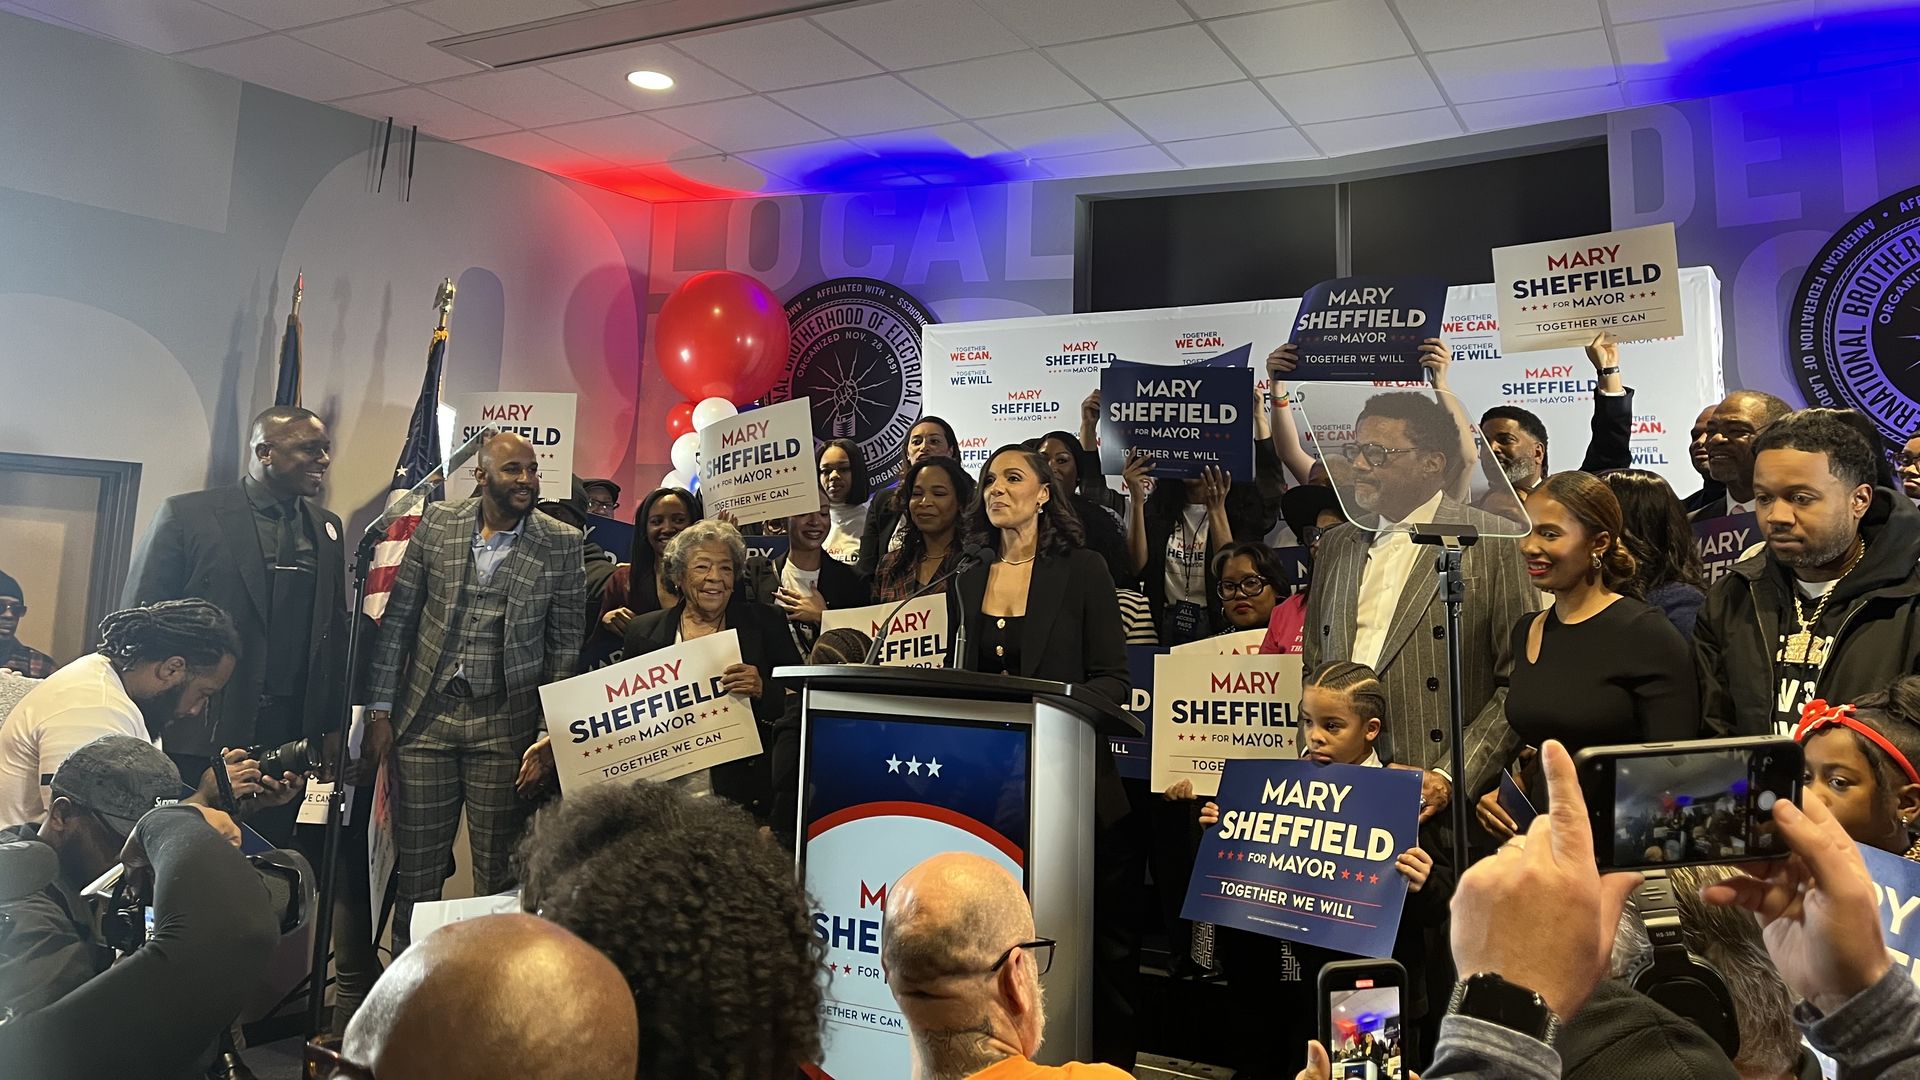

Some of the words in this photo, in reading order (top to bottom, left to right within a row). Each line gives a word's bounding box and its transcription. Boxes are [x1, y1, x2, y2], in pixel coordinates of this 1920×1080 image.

[1820, 218, 1876, 275] AMERICAN
[1547, 244, 1621, 271] MARY
[1513, 263, 1662, 299] SHEFFIELD
[816, 283, 863, 300] AFFILIATED
[864, 284, 886, 297] WITH
[1328, 287, 1394, 306] MARY
[1572, 292, 1625, 308] MAYOR
[867, 311, 888, 331] OF
[1297, 309, 1427, 330] SHEFFIELD
[1536, 319, 1597, 332] TOGETHER
[1602, 315, 1618, 325] WE
[1622, 312, 1646, 323] CAN
[1800, 276, 1828, 351] FEDERATION
[1443, 323, 1466, 333] WE
[1063, 341, 1099, 352] MARY
[1175, 339, 1194, 349] WE
[1196, 337, 1225, 348] CAN,
[1340, 332, 1387, 344] MAYOR
[797, 333, 840, 378] ORGANIZED
[845, 331, 867, 342] NOV.
[871, 339, 883, 353] 28,
[884, 353, 899, 375] 1891
[950, 352, 966, 361] WE
[967, 351, 992, 361] CAN,
[1045, 352, 1117, 367] SHEFFIELD
[1305, 354, 1357, 364] TOGETHER
[1360, 354, 1376, 363] WE
[1380, 354, 1405, 363] WILL
[1468, 349, 1502, 360] WILL
[1802, 355, 1819, 371] OF
[885, 323, 922, 405] ELECTRICAL
[1525, 365, 1574, 379] MARY
[951, 376, 966, 386] WE
[968, 375, 992, 385] WILL
[1136, 380, 1202, 398] MARY
[1502, 380, 1598, 396] SHEFFIELD
[1008, 390, 1042, 401] MARY
[1539, 396, 1574, 404] MAYOR
[482, 404, 534, 421] MARY
[991, 402, 1060, 415] SHEFFIELD
[1109, 402, 1238, 424] SHEFFIELD
[722, 420, 769, 449] MARY
[860, 412, 914, 462] WORKER
[1151, 427, 1200, 439] MAYOR
[1305, 432, 1325, 441] WE
[706, 438, 801, 479] SHEFFIELD
[1121, 449, 1170, 459] TOETHER
[1173, 450, 1190, 460] WE
[1193, 451, 1219, 461] WILL
[721, 478, 733, 486] FOR
[734, 467, 772, 485] MAYOR
[714, 496, 752, 511] TOGETHER
[753, 492, 767, 501] WE
[769, 488, 789, 499] CAN
[1179, 608, 1193, 616] ALL
[1177, 620, 1192, 629] PASS
[605, 659, 682, 703] MARY
[1211, 672, 1280, 694] MARY
[569, 676, 730, 744] SHEFFIELD
[1171, 699, 1298, 728] SHEFFIEL
[618, 734, 636, 746] FOR
[639, 713, 695, 742] MAYOR
[1211, 734, 1229, 743] FOR
[1232, 733, 1284, 748] MAYOR
[602, 749, 669, 778] TOGETHER
[672, 740, 691, 753] WE
[696, 732, 722, 747] CAN
[1192, 760, 1224, 771] TOGE
[1261, 778, 1352, 814] MARY
[1218, 810, 1395, 862] SHEFFIELD
[1247, 852, 1267, 865] FOR
[1268, 851, 1337, 880] MAYOR
[1220, 881, 1288, 906] TOGETHER
[1292, 894, 1315, 912] WE
[1320, 899, 1355, 920] WILL
[857, 965, 880, 979] FOR
[860, 1012, 877, 1024] WE
[879, 1015, 904, 1030] CAN,
